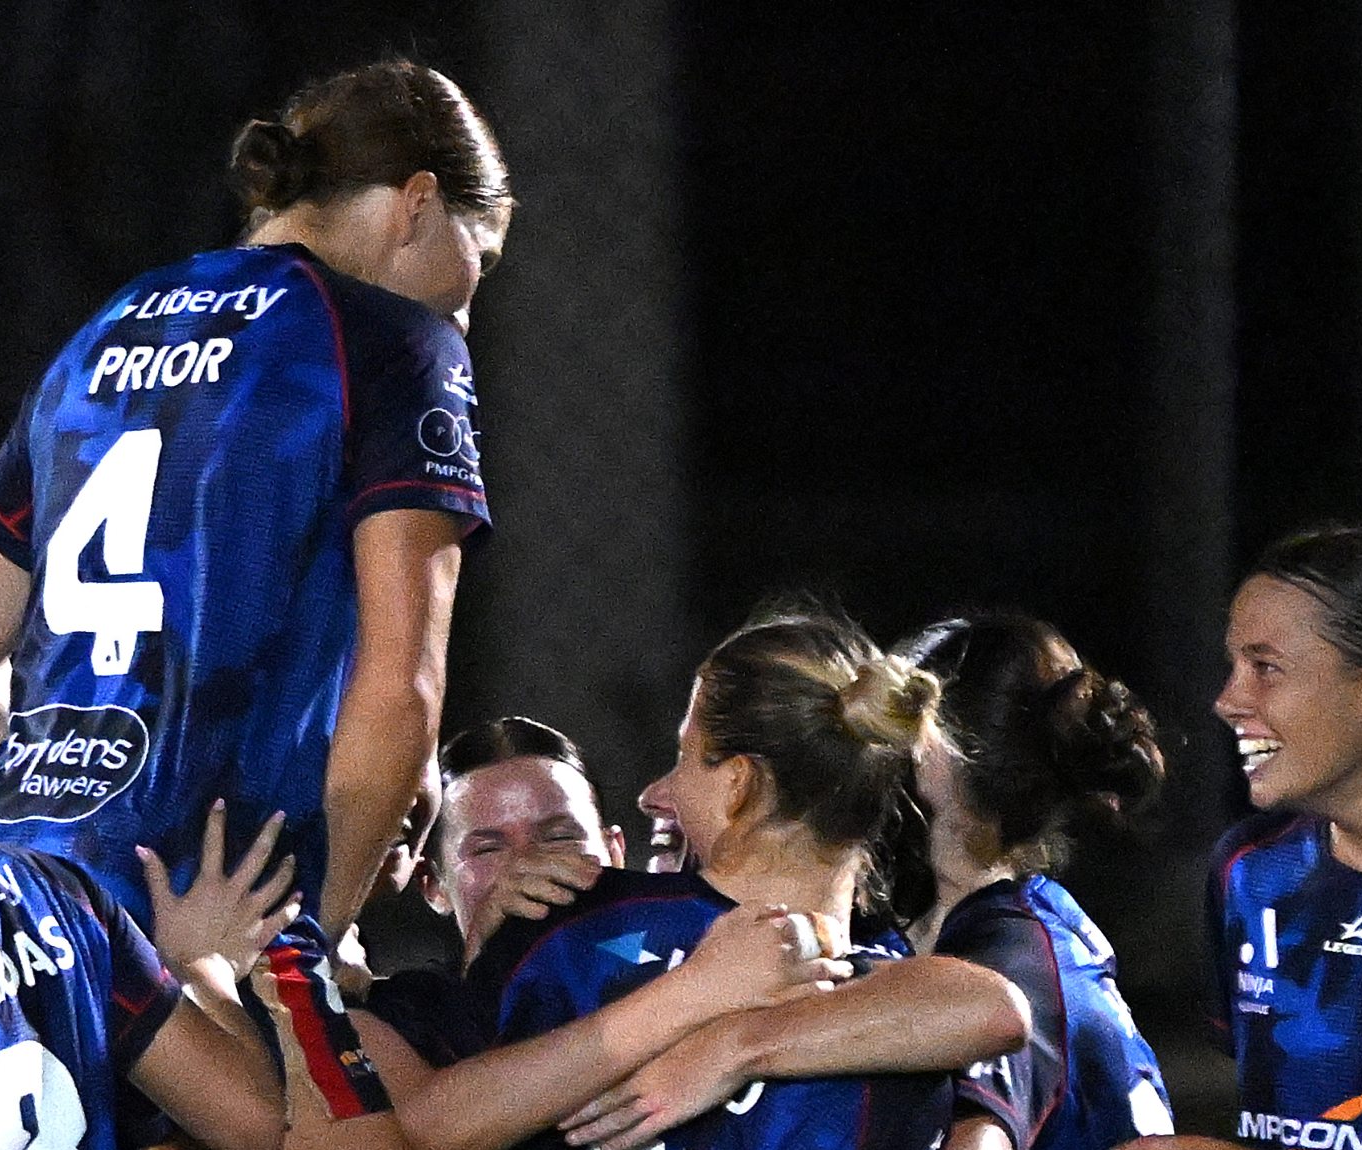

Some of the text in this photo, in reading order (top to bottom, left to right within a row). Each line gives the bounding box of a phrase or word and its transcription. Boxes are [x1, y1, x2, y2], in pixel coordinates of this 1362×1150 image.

[136, 284, 288, 320] Liberty
[88, 337, 233, 395] PRIOR
[43, 428, 164, 676] 4
